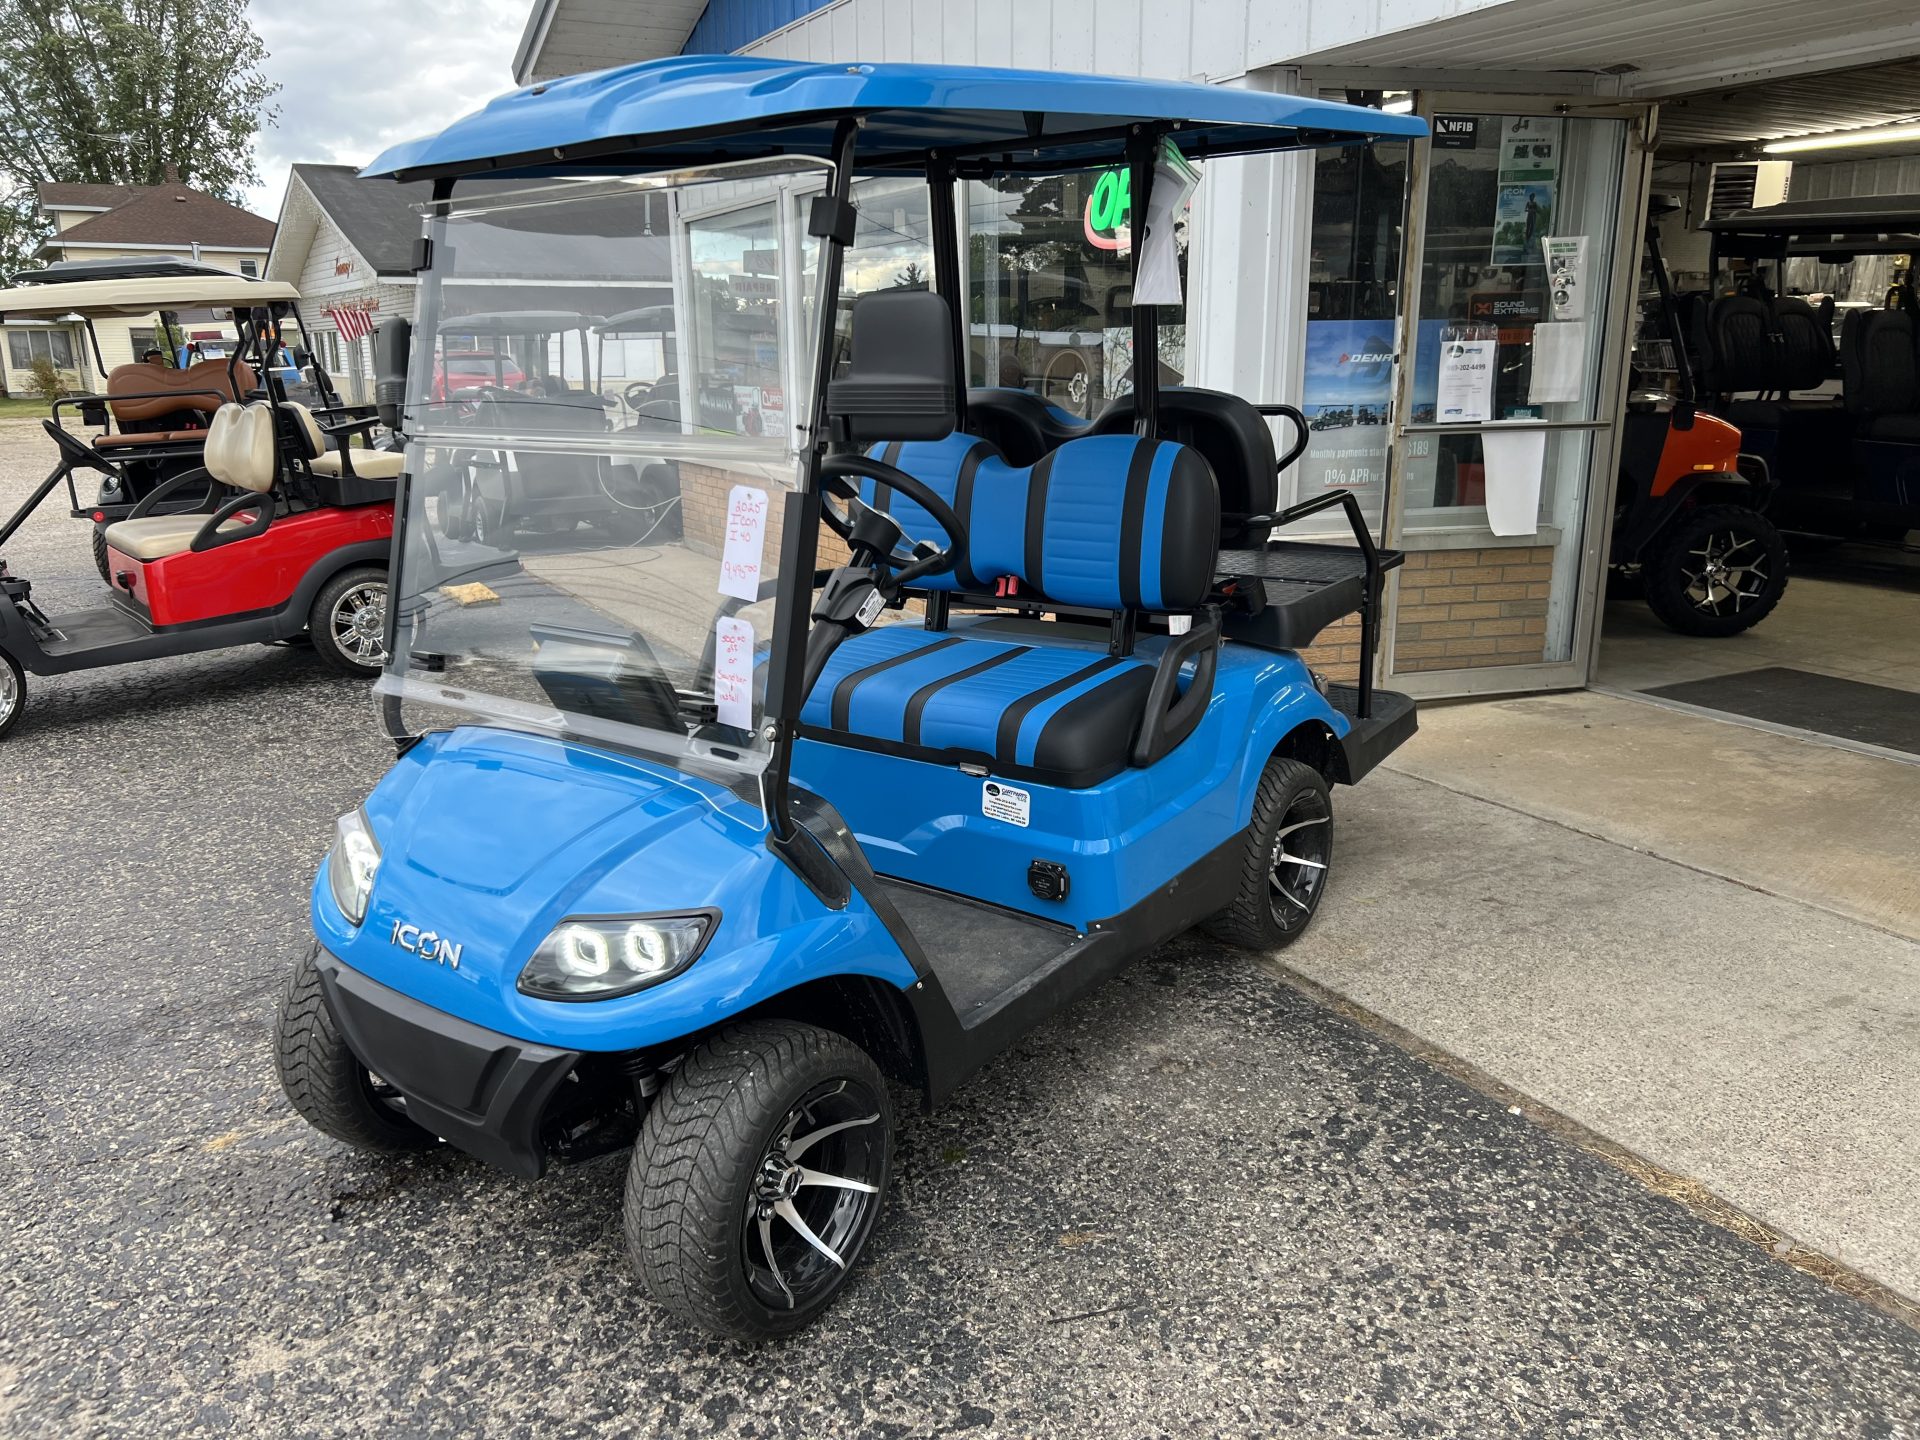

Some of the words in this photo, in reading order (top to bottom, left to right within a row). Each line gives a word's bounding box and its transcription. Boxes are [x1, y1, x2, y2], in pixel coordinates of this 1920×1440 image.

[1449, 121, 1474, 132] NFIB
[1503, 188, 1526, 196] ICON
[1090, 168, 1131, 231] OP
[1493, 307, 1540, 315] EXTREME
[1350, 353, 1394, 363] DENA
[1310, 448, 1336, 459] Monthly
[1337, 449, 1368, 459] payments
[1369, 448, 1385, 457] start
[1407, 440, 1429, 455] $189
[1324, 469, 1346, 484] 0%
[1349, 468, 1370, 483] APR
[735, 501, 766, 514] 2025
[391, 919, 464, 970] ICON
